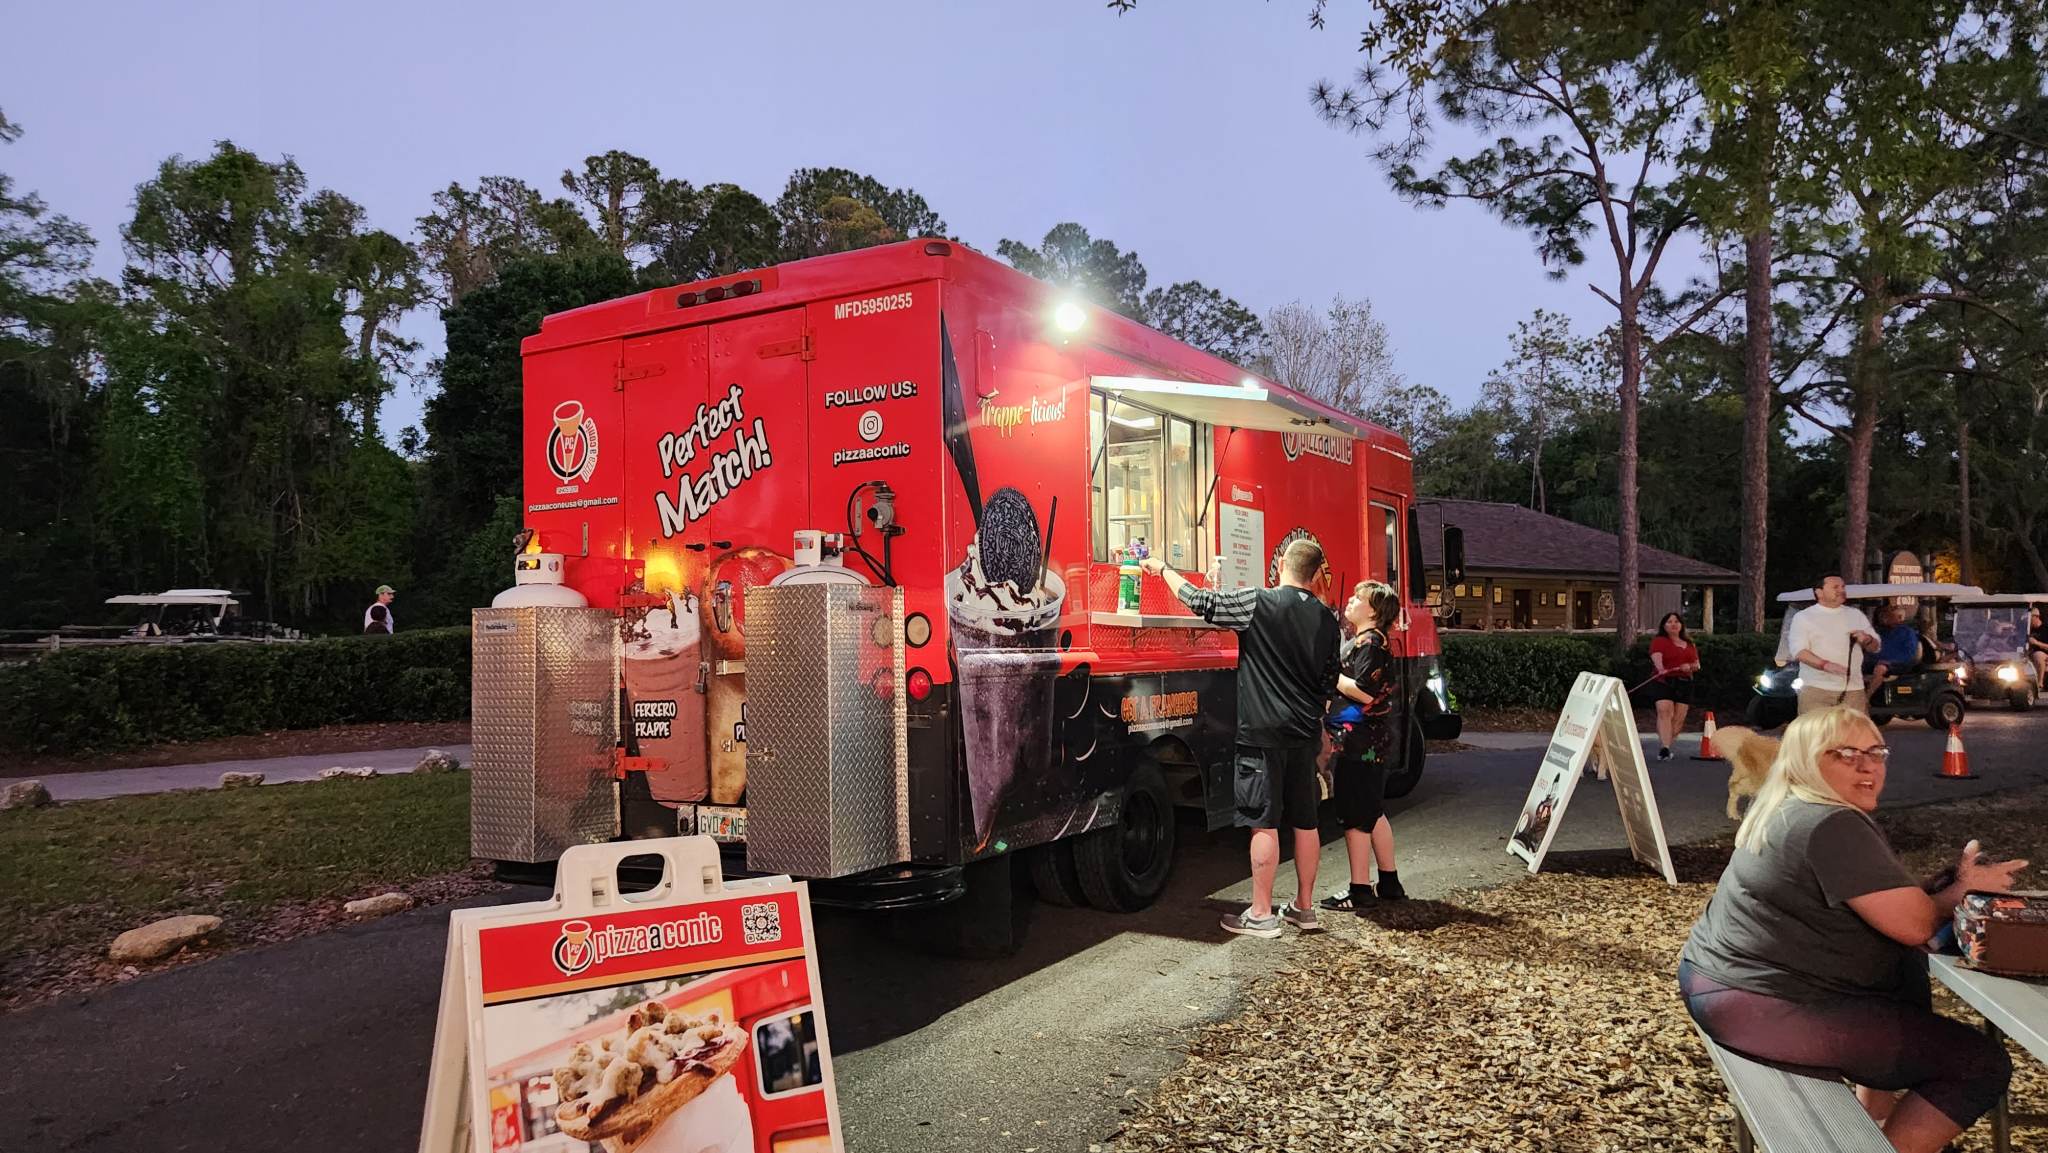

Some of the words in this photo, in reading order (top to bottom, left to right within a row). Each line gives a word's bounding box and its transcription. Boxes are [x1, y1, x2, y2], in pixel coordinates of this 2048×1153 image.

[834, 292, 913, 320] MFD5950255
[825, 384, 887, 407] FOLLOW
[891, 380, 918, 398] US:
[658, 384, 743, 477] Perfect
[833, 442, 910, 466] pizzaaconic
[655, 418, 771, 538] Match!
[634, 702, 677, 718] FERRERO
[1140, 696, 1150, 720] A
[635, 721, 670, 737] FRAPPE
[594, 913, 722, 962] pizzaaconic
